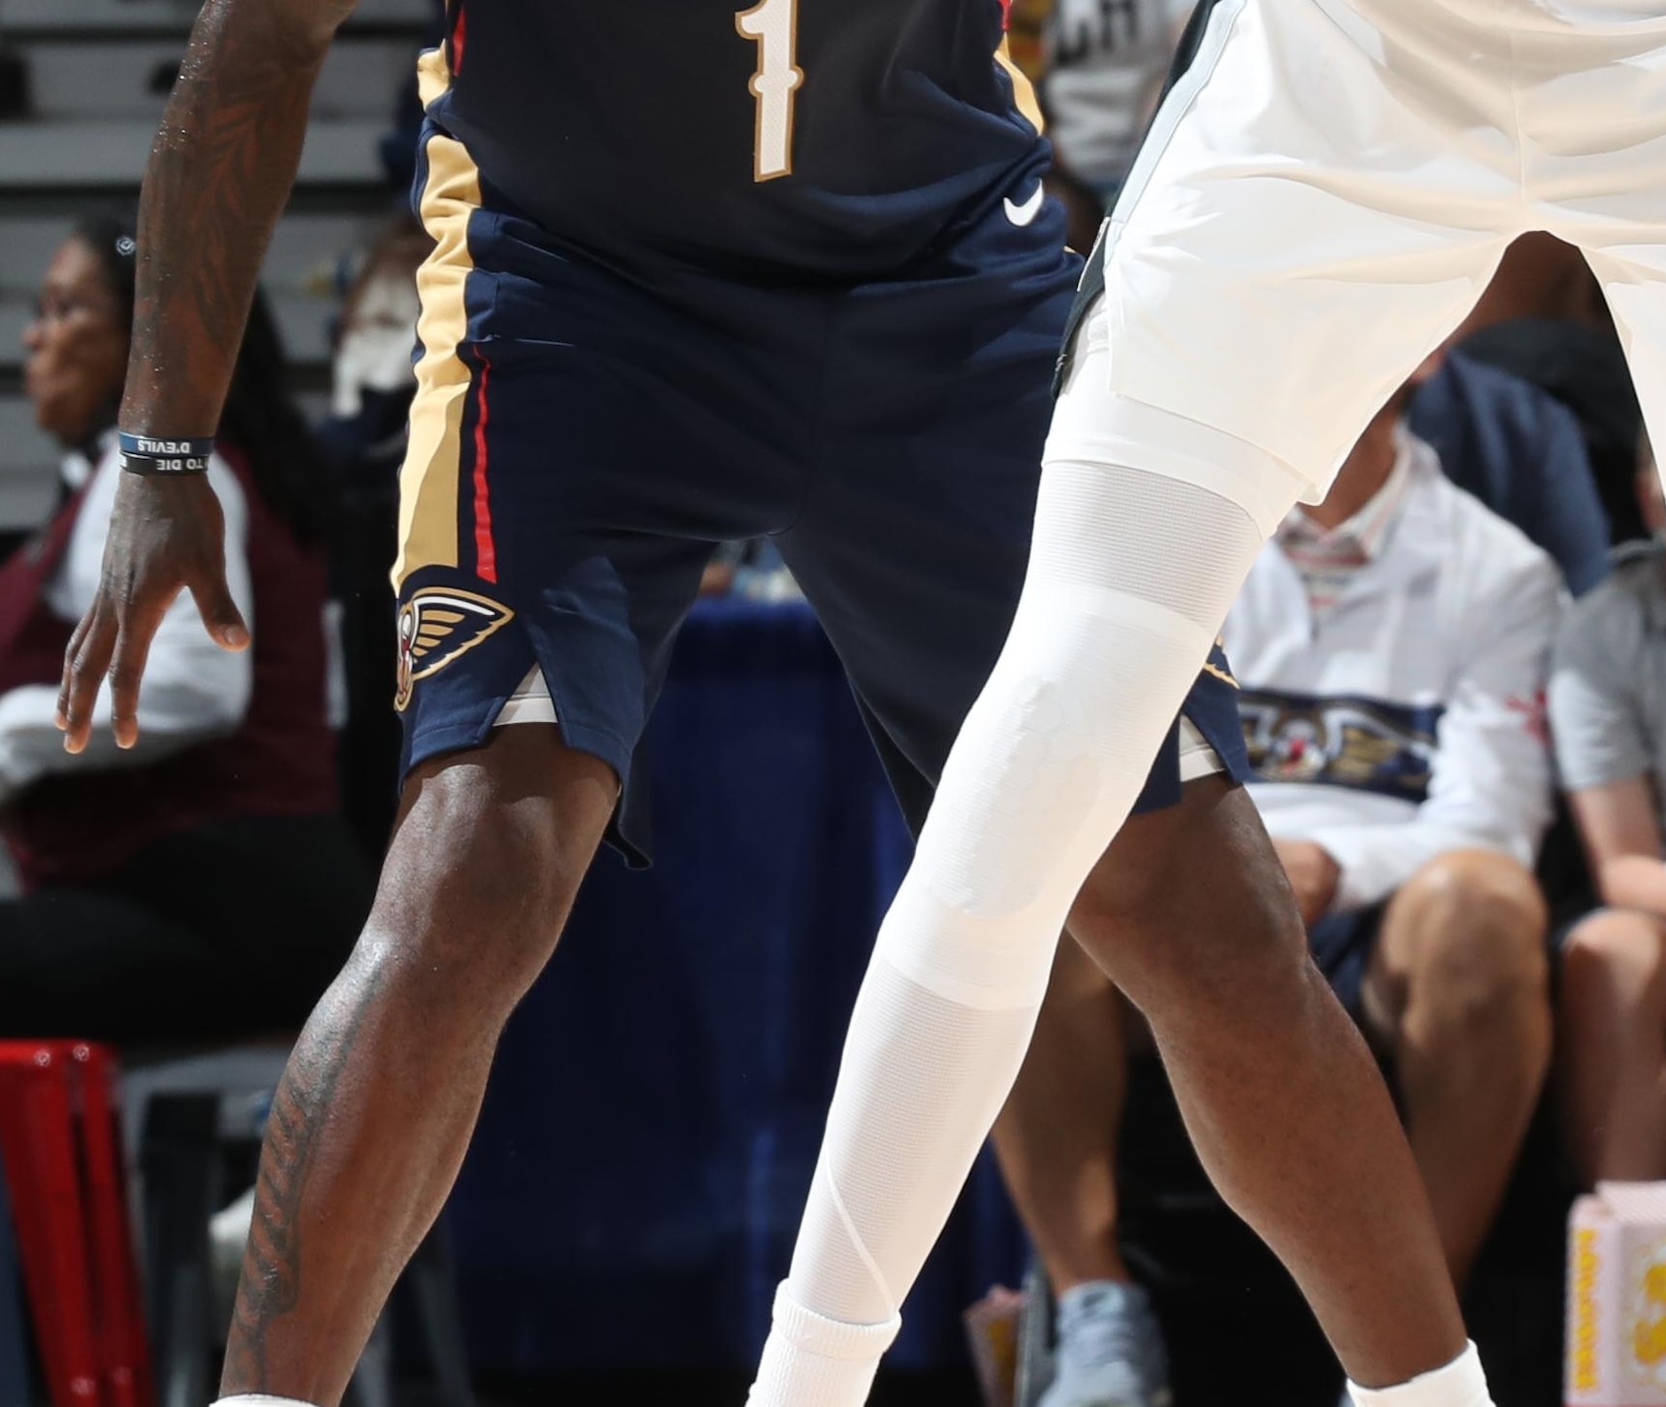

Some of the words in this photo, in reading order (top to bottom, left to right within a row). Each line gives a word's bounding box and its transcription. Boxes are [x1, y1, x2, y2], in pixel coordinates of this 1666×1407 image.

[137, 439, 191, 454] D'EVILS
[156, 459, 182, 471] DIE
[186, 458, 204, 470] TO
